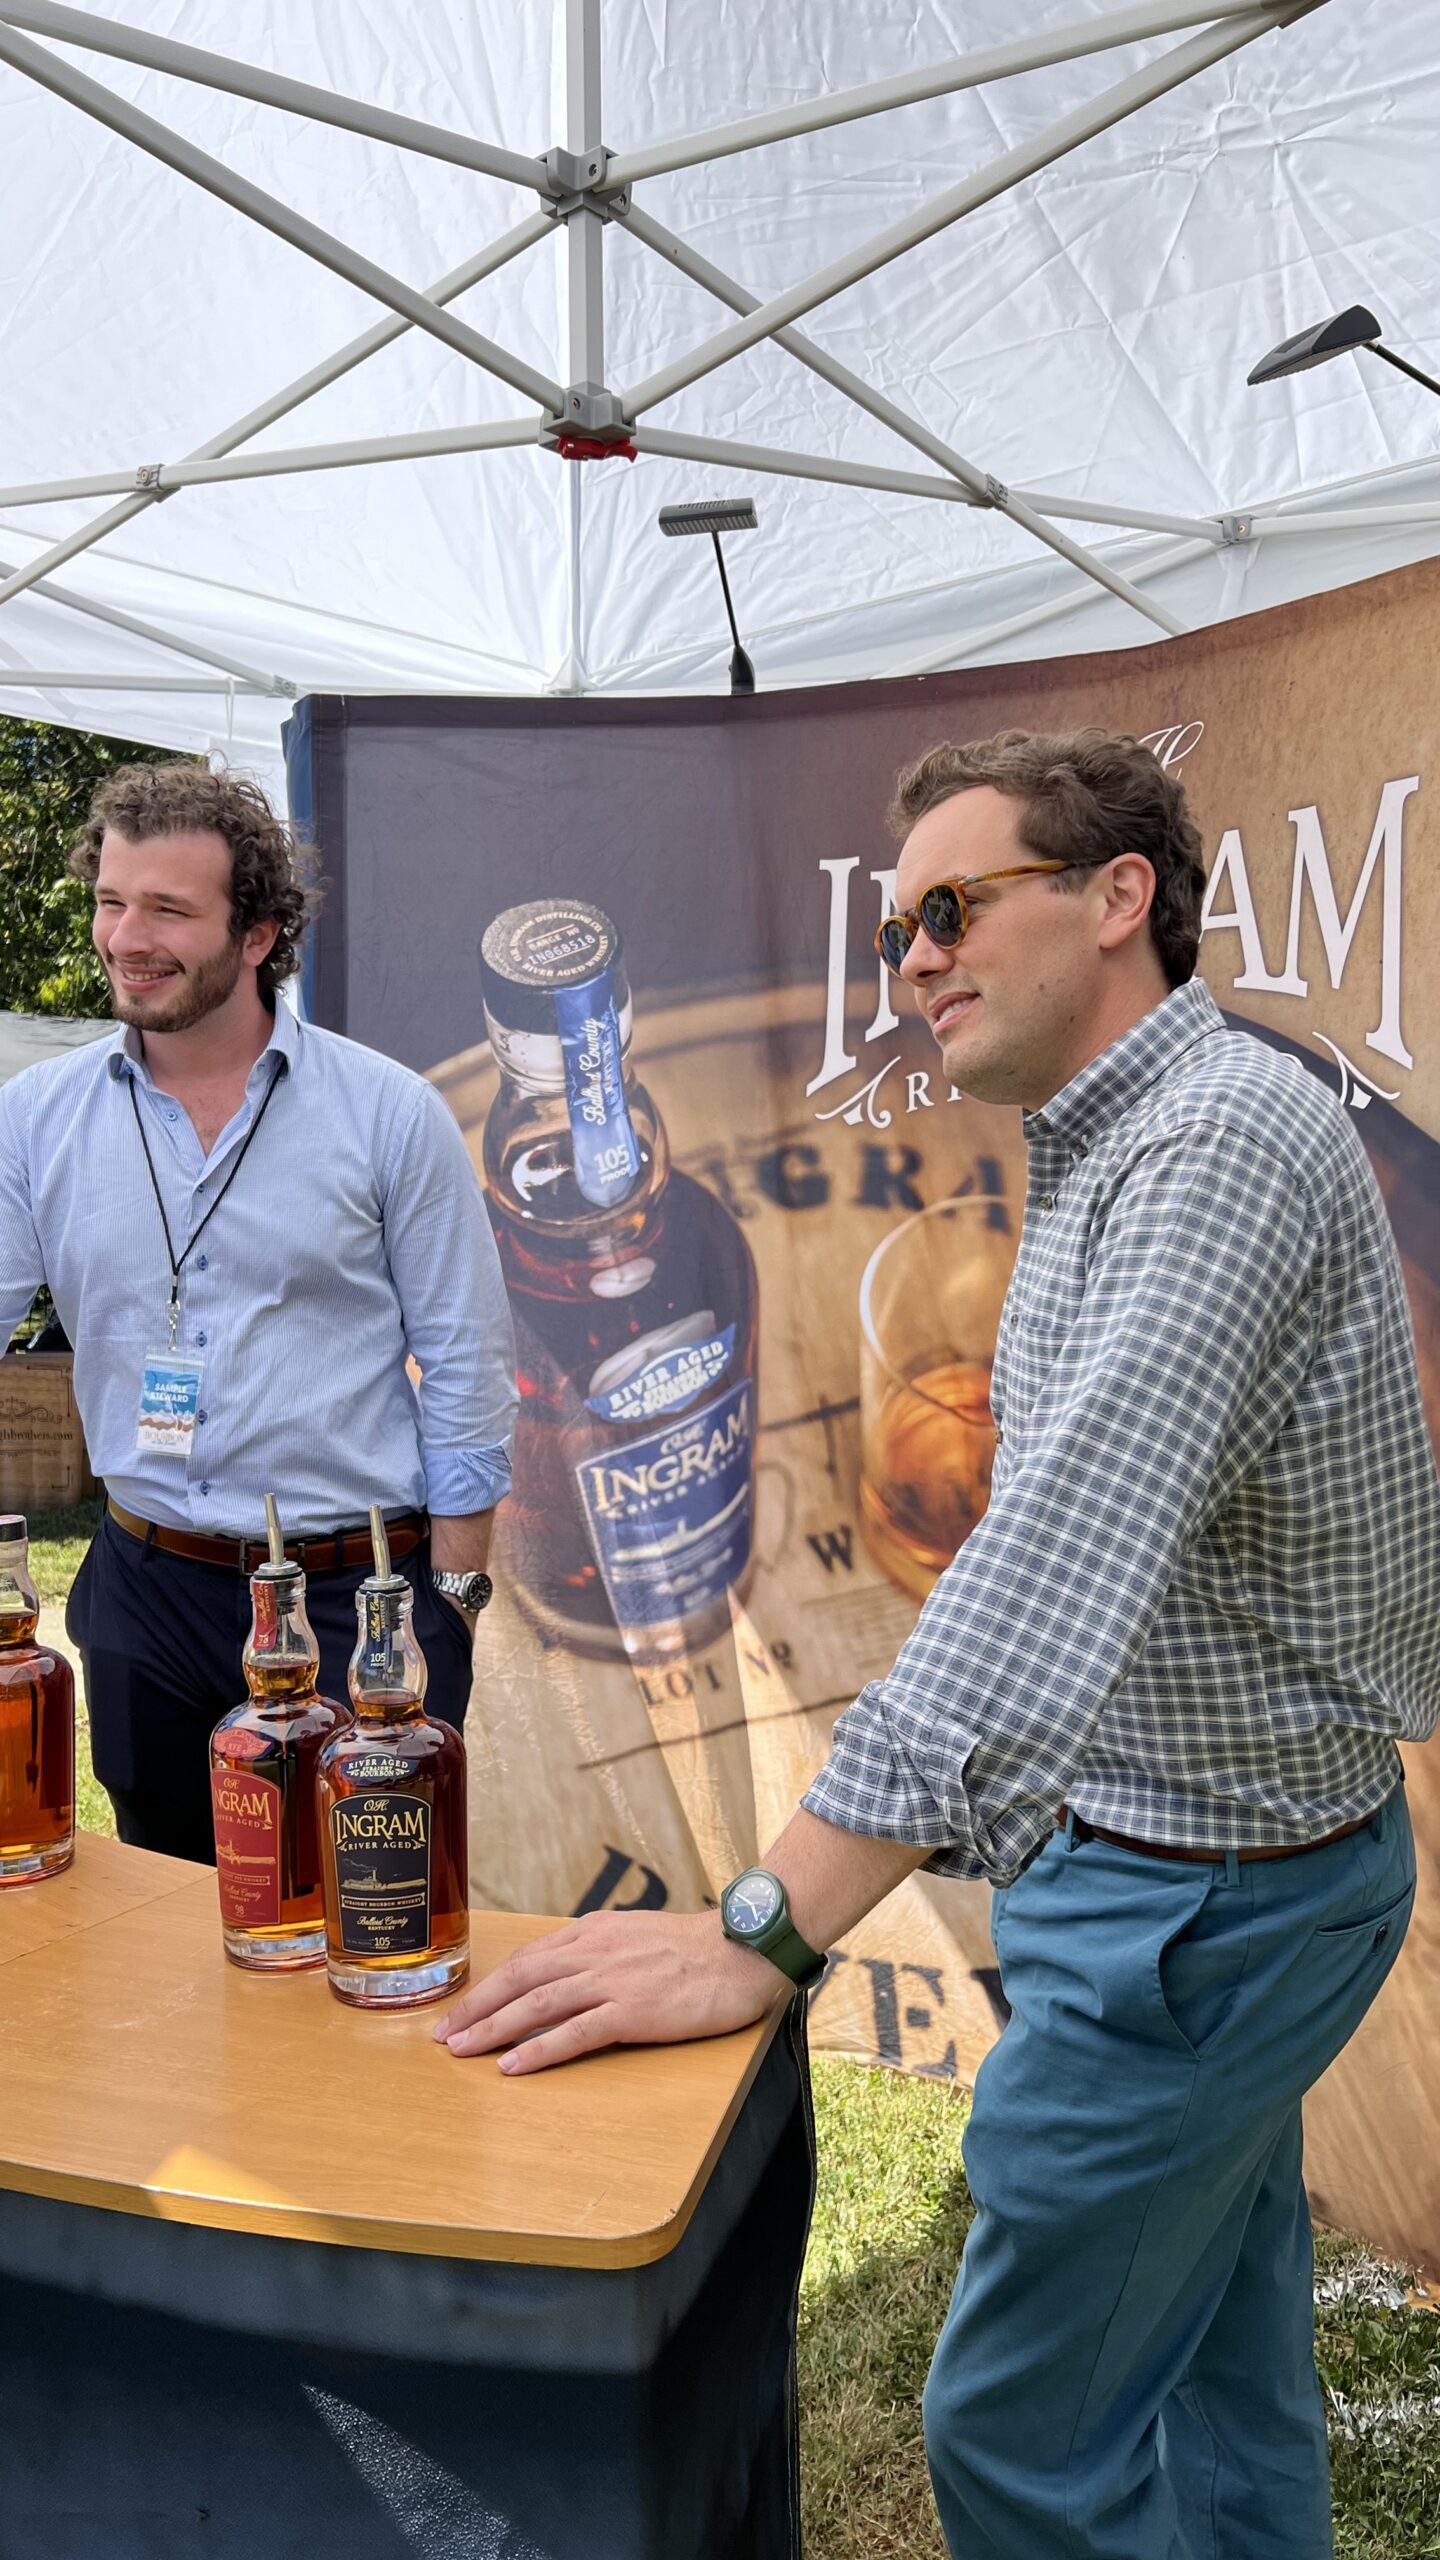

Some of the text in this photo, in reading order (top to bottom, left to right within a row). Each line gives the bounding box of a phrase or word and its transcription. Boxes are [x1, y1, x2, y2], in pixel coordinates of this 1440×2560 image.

[806, 775, 1420, 1097] IAM
[527, 934, 597, 965] IN068518
[522, 962, 554, 977] RIVER
[556, 965, 586, 977] AGED
[578, 1018, 605, 1071] County
[594, 1144, 630, 1174] 105
[609, 1341, 724, 1410] RIVER AGED
[155, 1383, 187, 1393] SAMPLE
[150, 1391, 189, 1403] STEWARD
[590, 1392, 748, 1511] INGRAM
[370, 1653, 386, 1662] 105
[348, 1758, 409, 1770] RIVER AGED
[214, 1787, 272, 1825] NGRAM
[236, 1819, 261, 1829] AGED
[335, 1807, 427, 1846] INGRAM
[348, 1841, 412, 1850] RIVER AGED
[384, 1915, 409, 1928] County
[374, 1936, 391, 1946] 105
